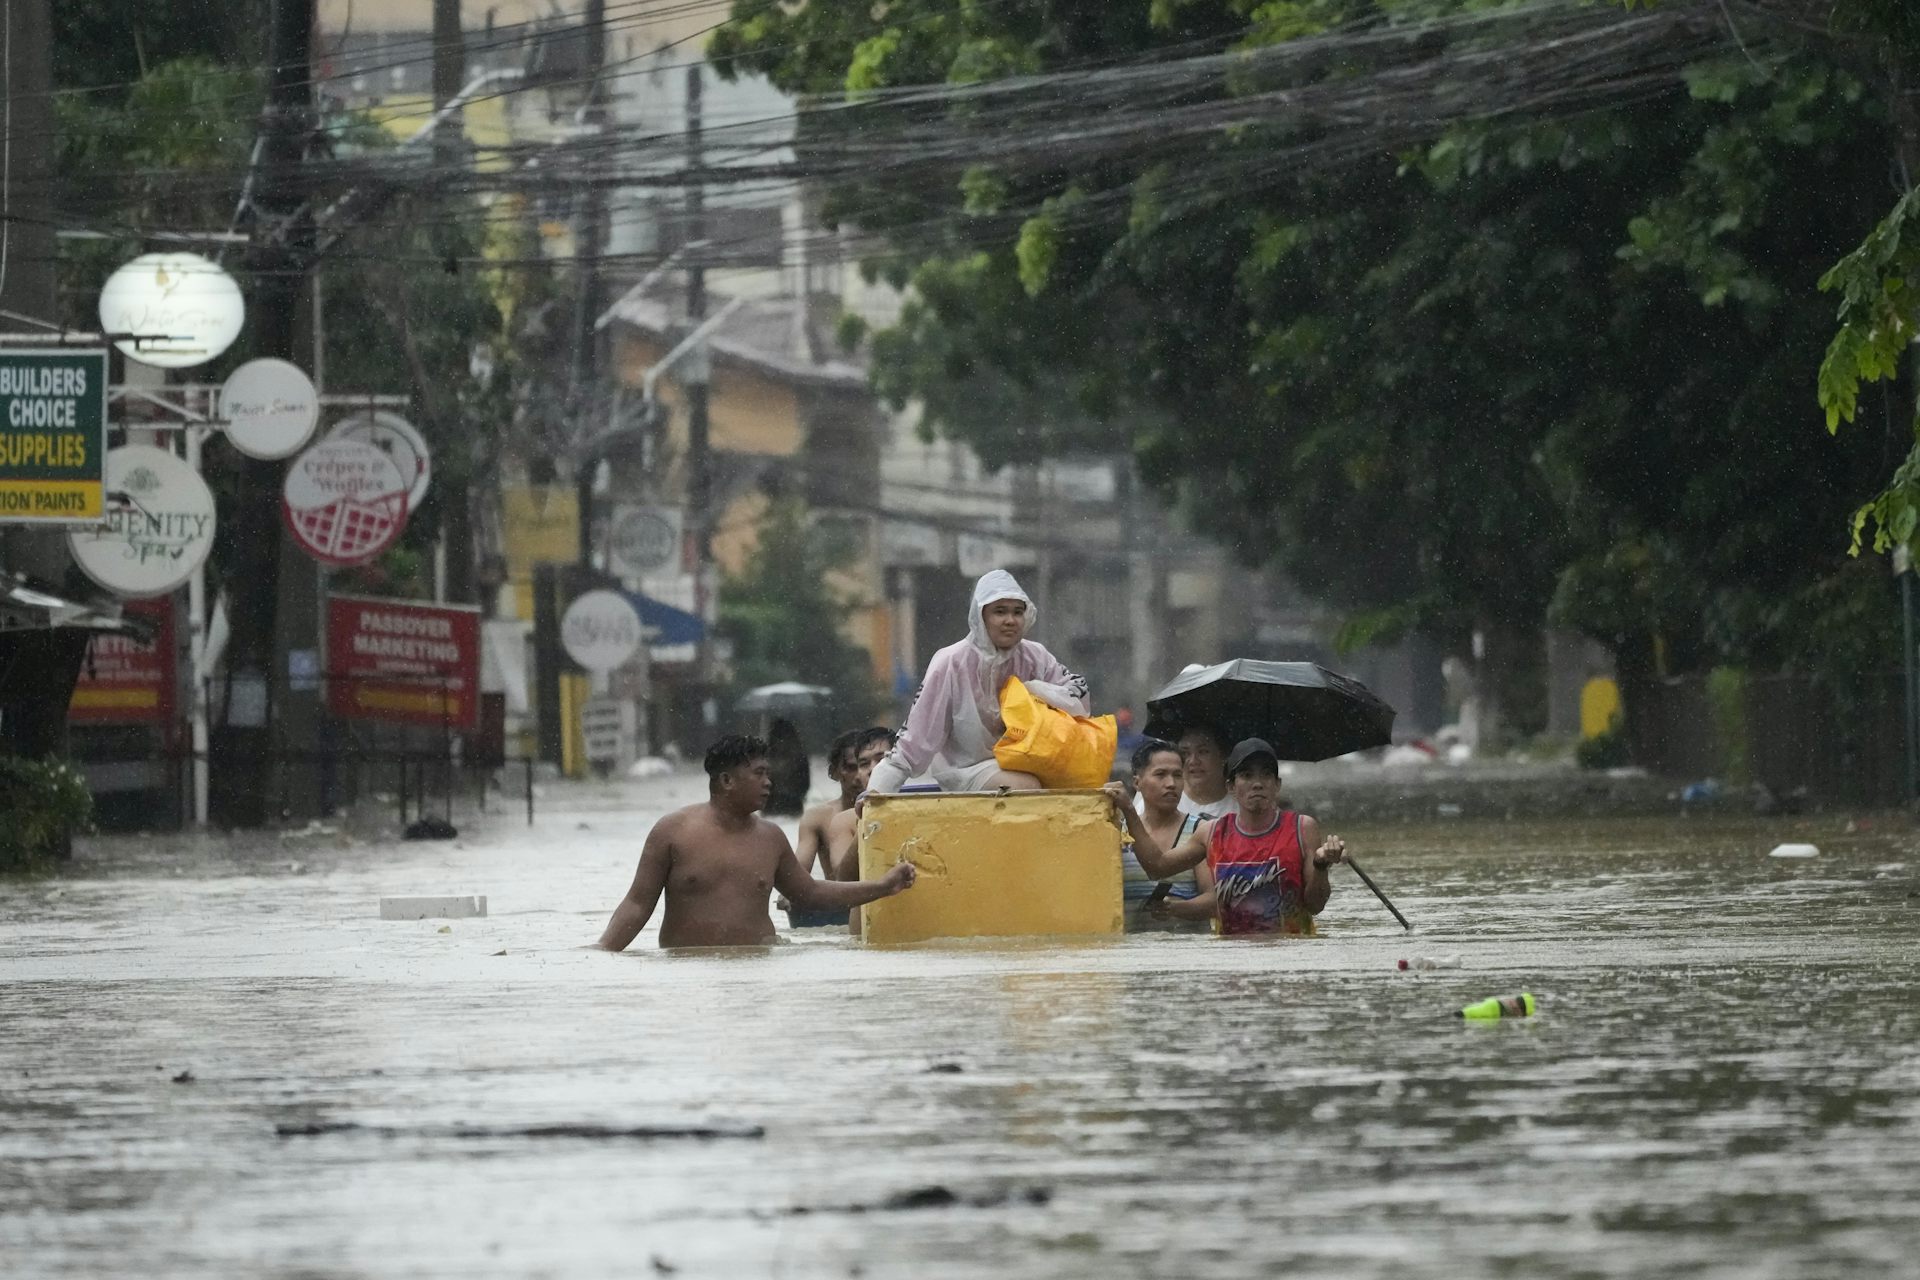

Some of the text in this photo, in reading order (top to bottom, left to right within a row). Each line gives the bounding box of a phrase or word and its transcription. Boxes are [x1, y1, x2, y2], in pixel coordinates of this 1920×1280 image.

[1, 366, 87, 396] BUILDERS
[9, 398, 76, 428] CHOICE
[0, 433, 86, 467] SUPPLIES
[0, 491, 86, 512] ION PAINTS
[122, 536, 167, 565] Spa
[360, 611, 452, 638] PASSOVER
[353, 633, 460, 663] MARKETING
